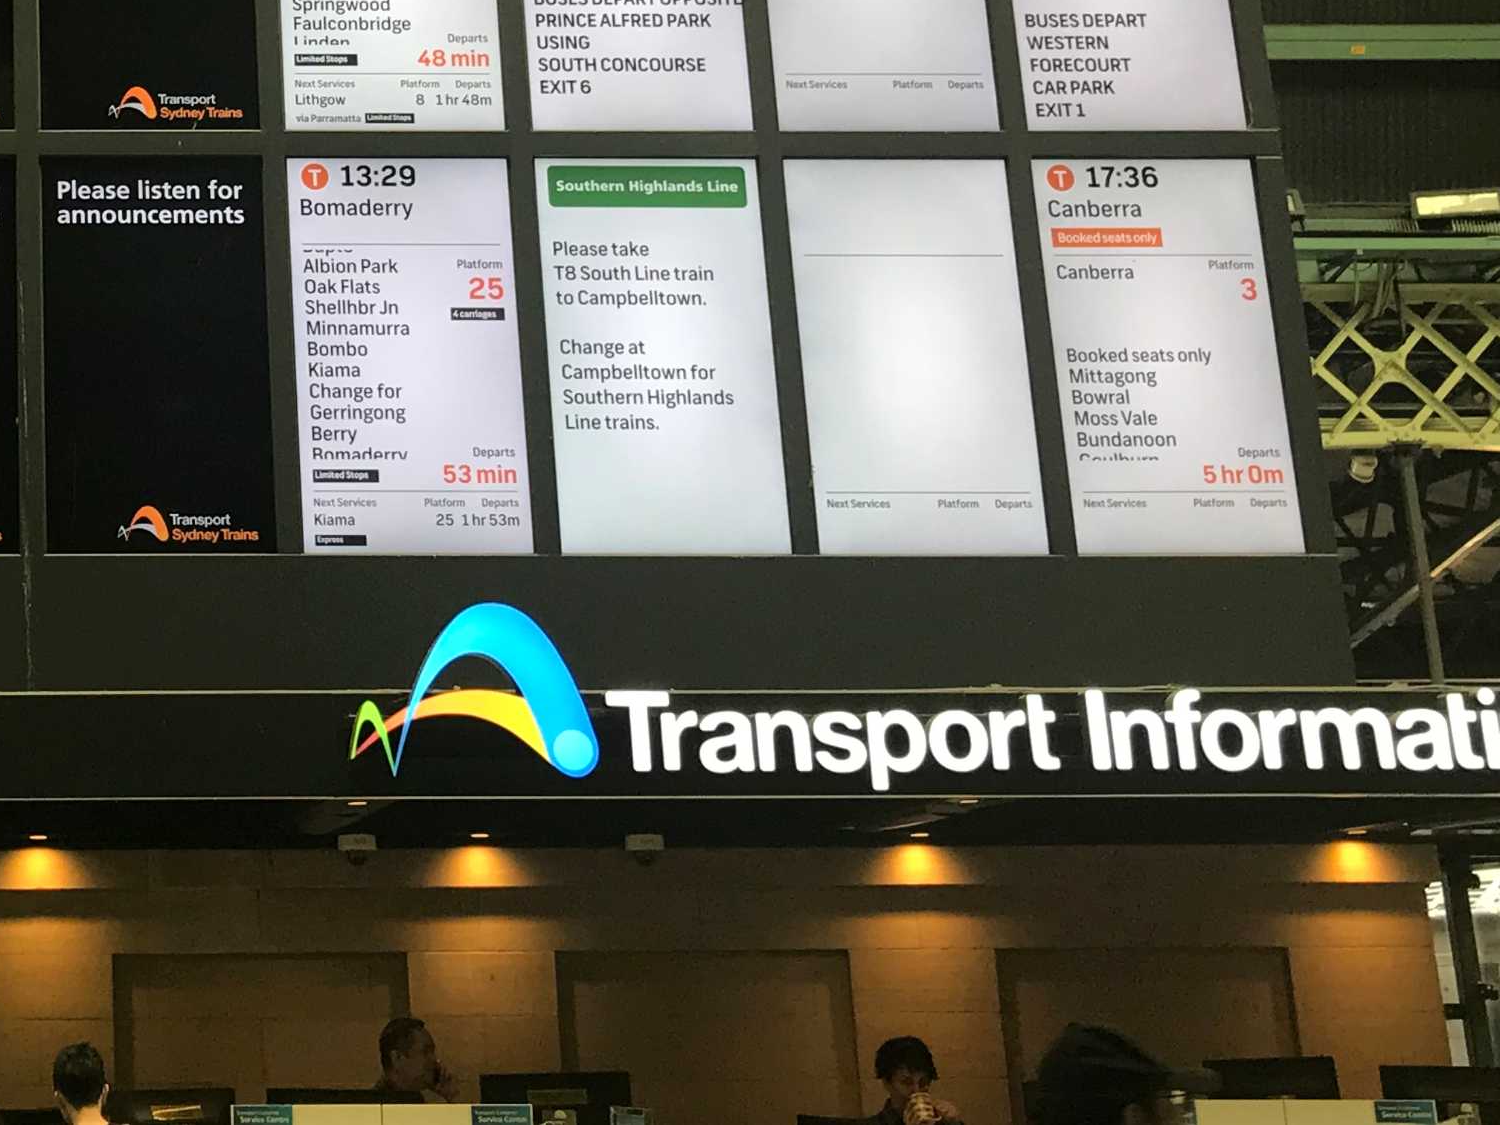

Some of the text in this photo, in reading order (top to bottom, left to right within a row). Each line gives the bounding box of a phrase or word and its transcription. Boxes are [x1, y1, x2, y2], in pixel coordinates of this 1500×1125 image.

[294, 16, 411, 34] Faulconbridge
[536, 14, 711, 27] PRINCE ALFRED PARK
[418, 50, 489, 67] 48 min
[1030, 58, 1130, 72] FORECOURT
[295, 80, 355, 88] Next Services
[400, 80, 440, 88] Platform
[455, 80, 491, 90] Departs
[540, 80, 591, 94] EXIT 6
[786, 80, 847, 89] Next Services
[893, 80, 932, 88] Platform
[948, 80, 984, 91] Departs
[1033, 81, 1114, 94] CAR PARK
[295, 94, 346, 108] Lithgow
[341, 165, 415, 186] 13:29
[1086, 166, 1158, 187] 17:36
[58, 180, 242, 199] Please listen for
[556, 180, 738, 195] Southern Highlands Line
[58, 207, 244, 223] announcements
[300, 199, 413, 220] Bomaderry
[1048, 200, 1141, 217] Canberra
[553, 241, 649, 256] Please take
[304, 259, 398, 273] Albion Park
[457, 259, 503, 269] Platform
[1209, 260, 1254, 269] Platform
[554, 266, 714, 281] T8 South Line train
[305, 279, 380, 294] Oak Flats
[470, 278, 503, 299] 25
[1241, 278, 1257, 300] 3
[556, 290, 706, 308] to Campbelltown.
[307, 321, 409, 335] Minnamurra
[1066, 348, 1211, 365] Booked seats only
[309, 362, 360, 377] Kiama
[1069, 368, 1157, 387] Mittagong
[1072, 390, 1129, 404] Bowral
[310, 404, 406, 423] Gerringong
[1074, 411, 1157, 426] Moss Vale
[444, 465, 517, 483] 53 min
[170, 514, 231, 527] Transport
[172, 528, 259, 543] Sydney Trains
[605, 689, 1061, 791] Transport
